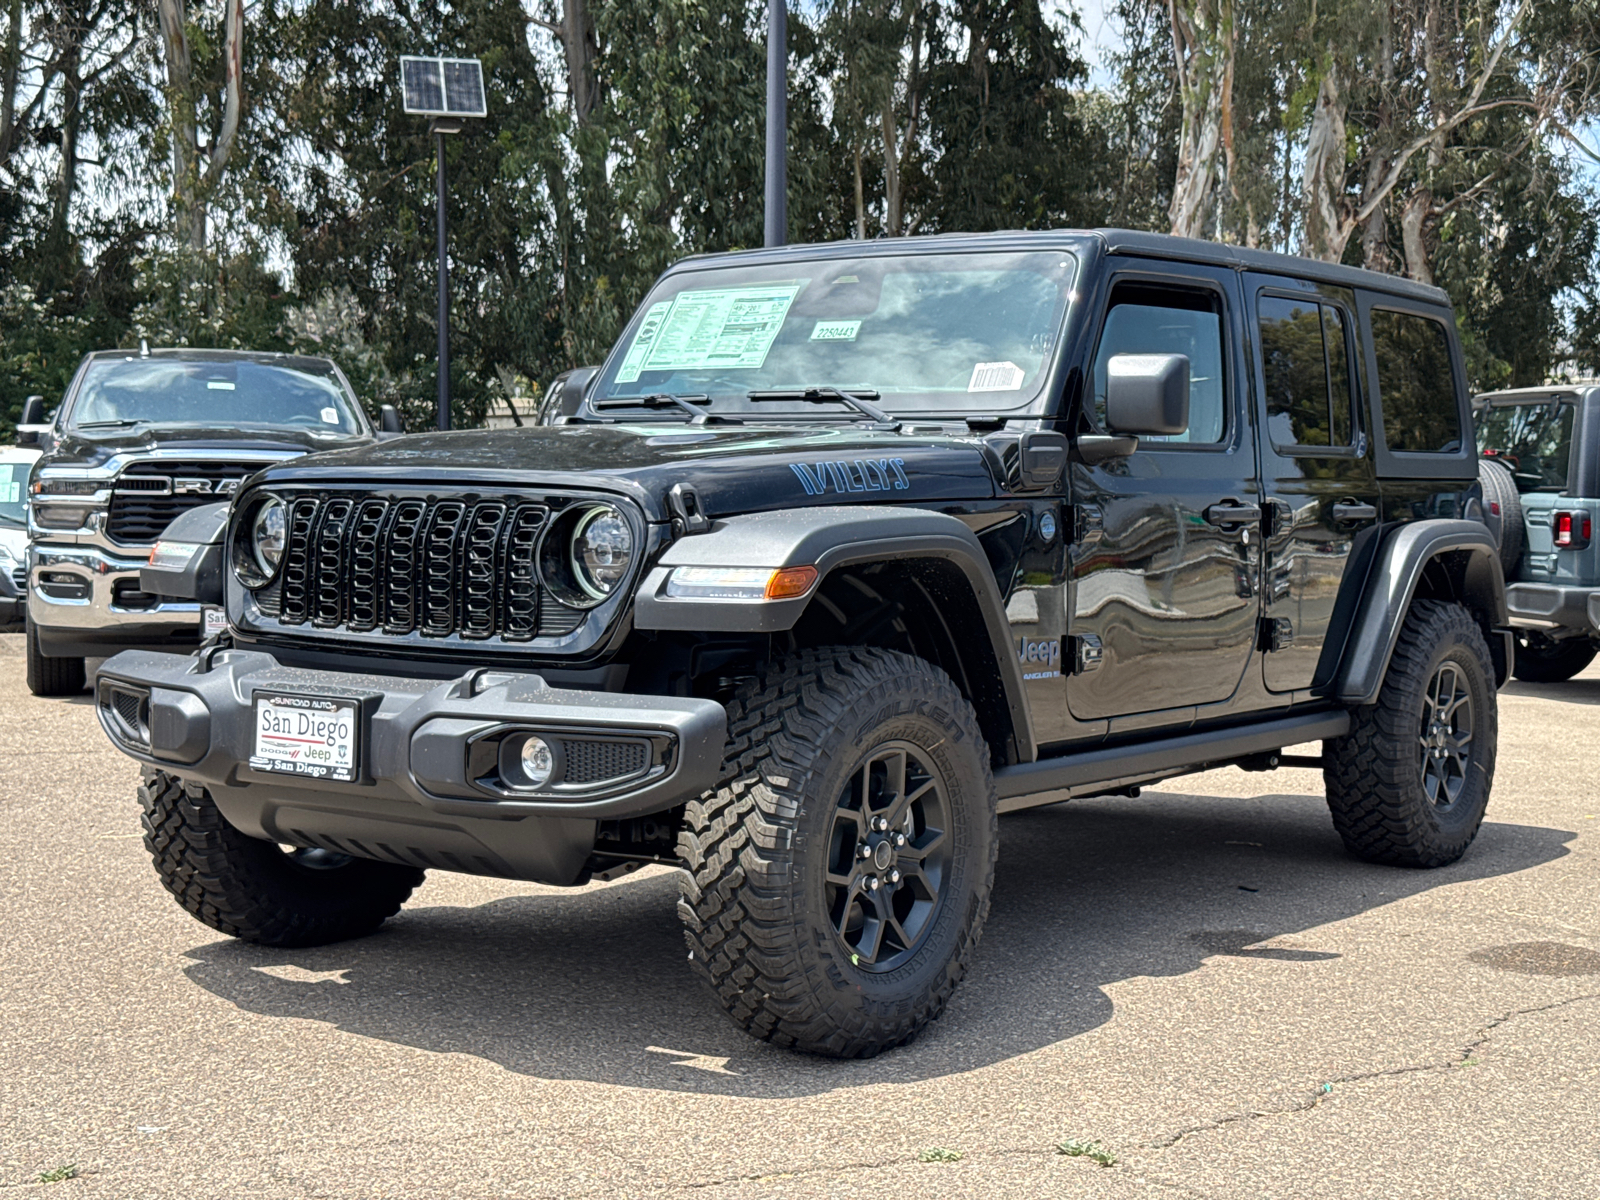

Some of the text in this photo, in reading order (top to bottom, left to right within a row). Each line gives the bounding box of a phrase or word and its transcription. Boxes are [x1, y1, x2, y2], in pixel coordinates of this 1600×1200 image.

[817, 327, 855, 338] 2250443
[789, 458, 910, 495] WILLYS
[174, 478, 241, 494] RA
[1017, 636, 1060, 666] Jeep
[1023, 671, 1053, 680] ANGLER
[274, 697, 332, 709] SUNROAD AUTO
[262, 709, 348, 747] San Diego
[304, 745, 331, 762] Jeep
[274, 759, 294, 771] San
[296, 762, 327, 777] Diego
